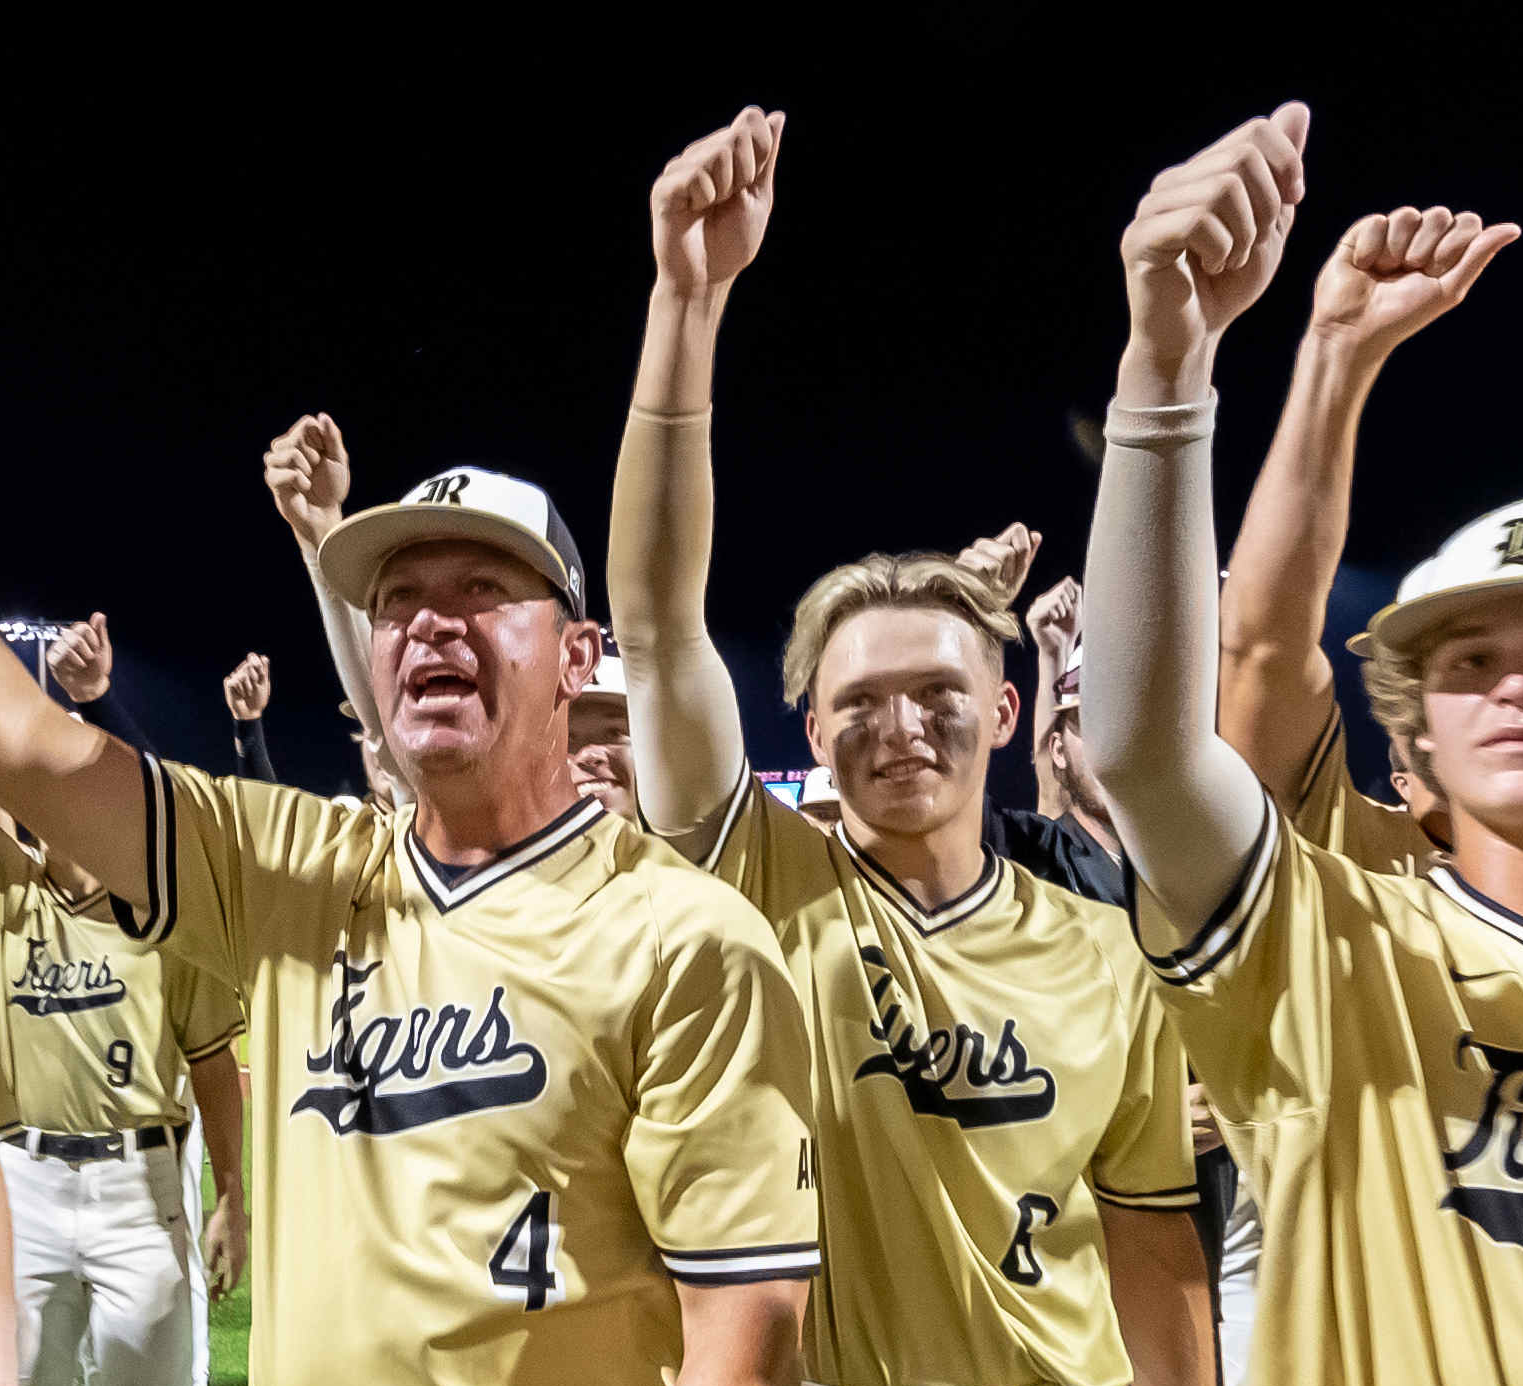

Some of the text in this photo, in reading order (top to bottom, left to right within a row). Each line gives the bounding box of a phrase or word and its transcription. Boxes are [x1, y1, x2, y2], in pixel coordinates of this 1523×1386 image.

[106, 1039, 134, 1088] 9
[487, 1190, 556, 1313] 4
[998, 1192, 1060, 1287] 6
